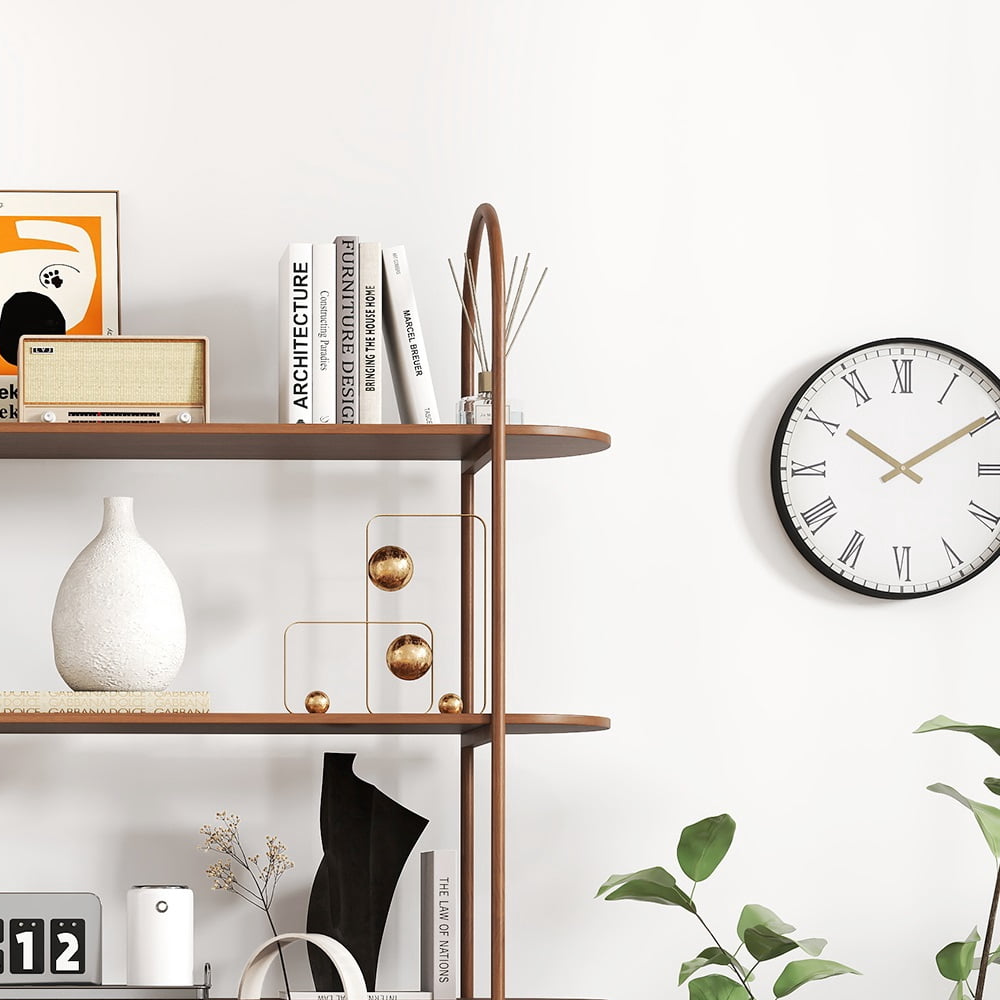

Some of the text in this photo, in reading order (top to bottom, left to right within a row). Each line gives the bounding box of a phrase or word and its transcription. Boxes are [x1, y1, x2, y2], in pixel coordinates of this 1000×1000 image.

[293, 262, 308, 409] ARCHITECTURE
[318, 290, 330, 371] Constructing Paradies
[342, 240, 354, 424] FURNITURE DESIG
[365, 286, 375, 392] BRINGING THE HOUSE HOME
[403, 310, 423, 377] MARCEL BREUER
[840, 369, 872, 408] XI
[891, 359, 913, 394] XII
[892, 546, 911, 582] VI
[439, 877, 449, 983] THE LAW OF NATIONS
